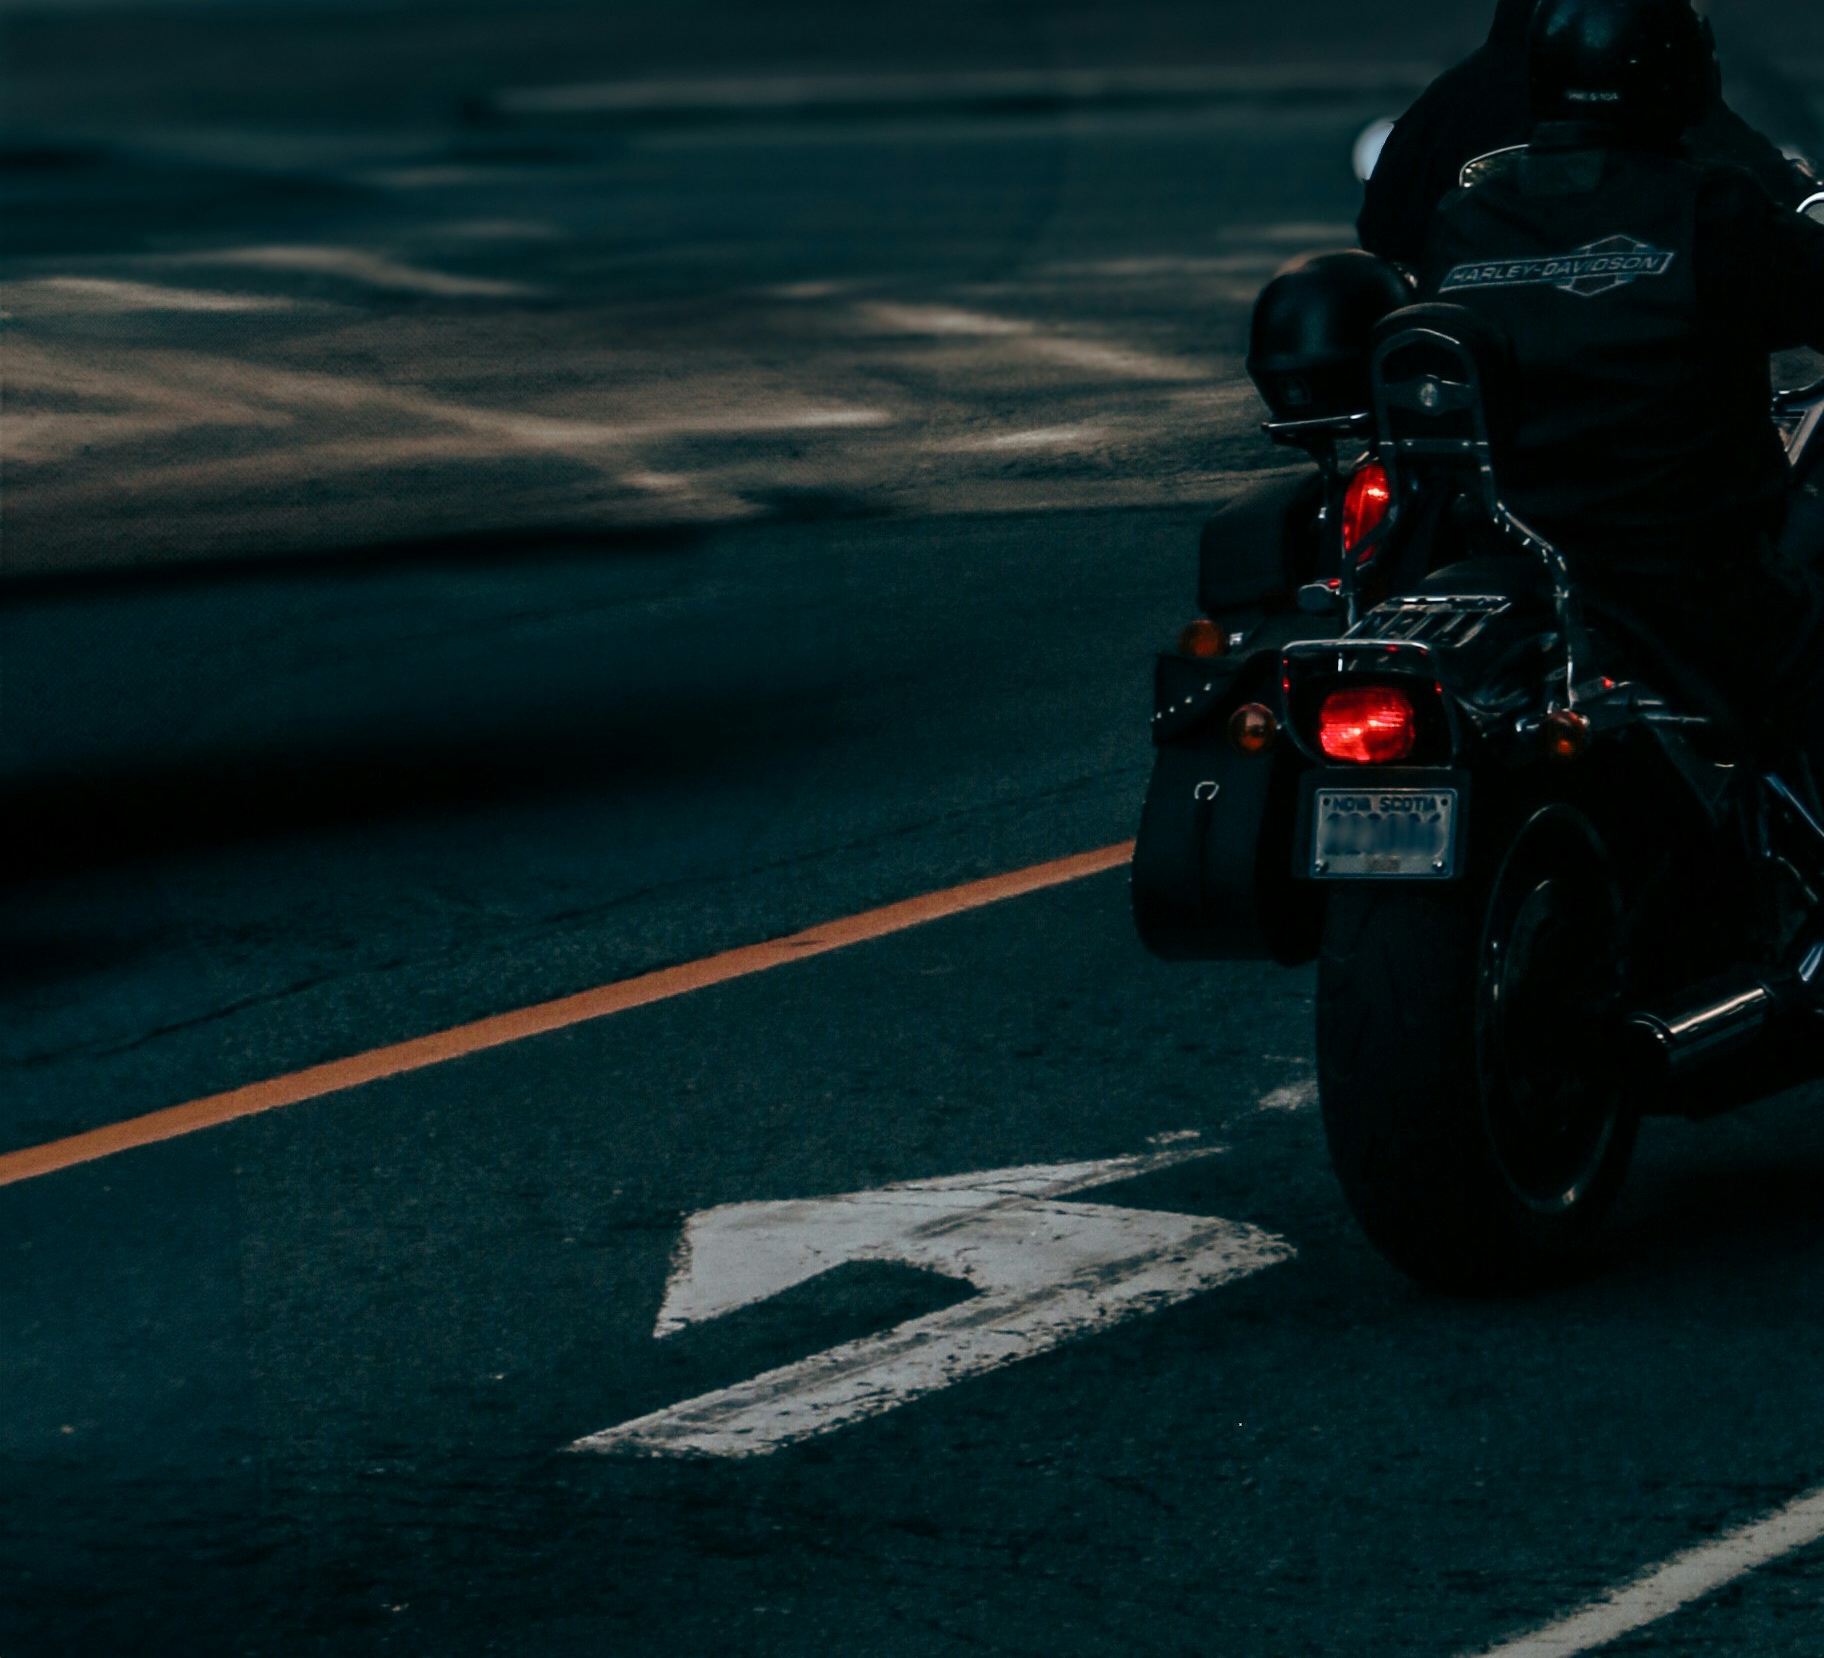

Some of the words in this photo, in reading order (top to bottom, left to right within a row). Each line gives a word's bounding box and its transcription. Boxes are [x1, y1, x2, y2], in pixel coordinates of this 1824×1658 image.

[1451, 256, 1660, 282] HARLEY-DAVIDSON
[1333, 796, 1371, 811] NOVA
[1379, 796, 1436, 812] SCOTIA
